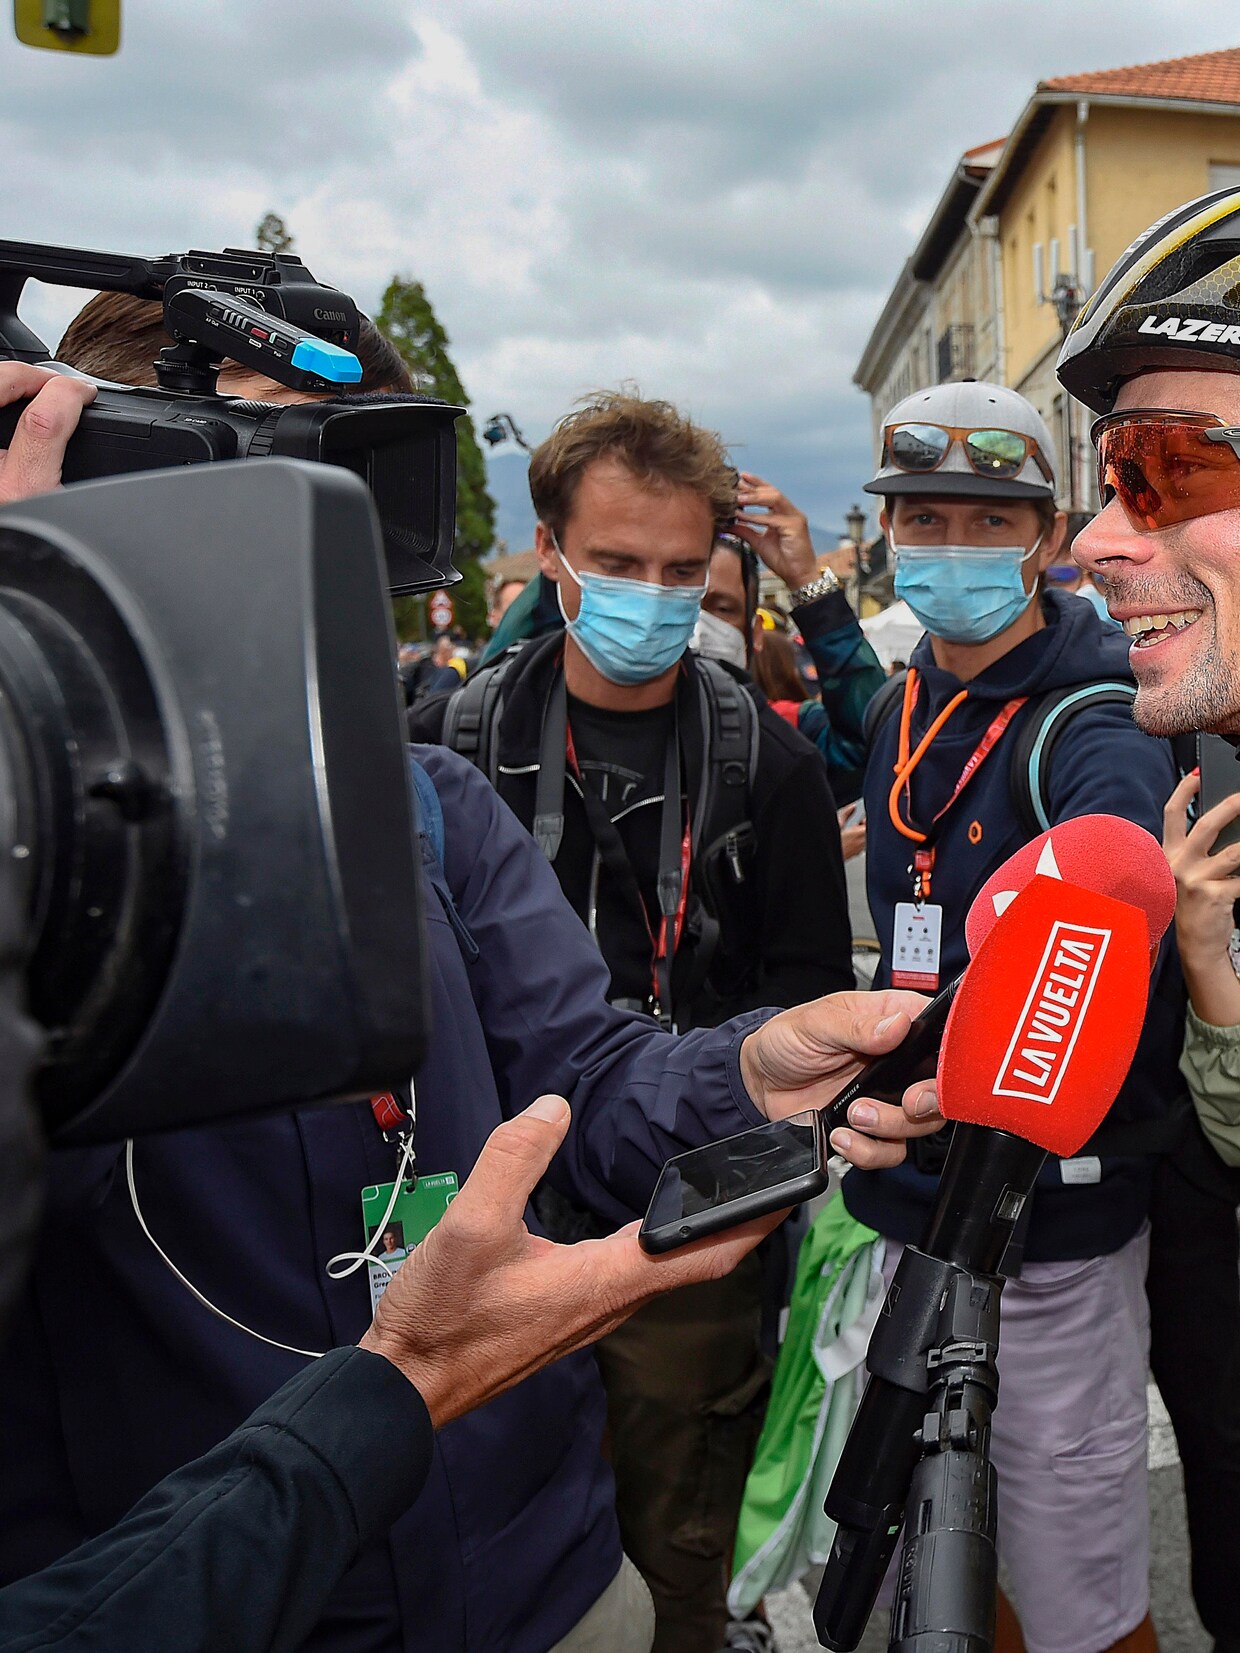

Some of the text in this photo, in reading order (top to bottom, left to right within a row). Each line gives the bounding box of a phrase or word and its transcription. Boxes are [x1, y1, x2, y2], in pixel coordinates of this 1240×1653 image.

[187, 280, 204, 289] INPUT
[234, 286, 251, 295] INPUT
[313, 307, 348, 323] Canon
[1012, 939, 1095, 1088] LA VUELTA
